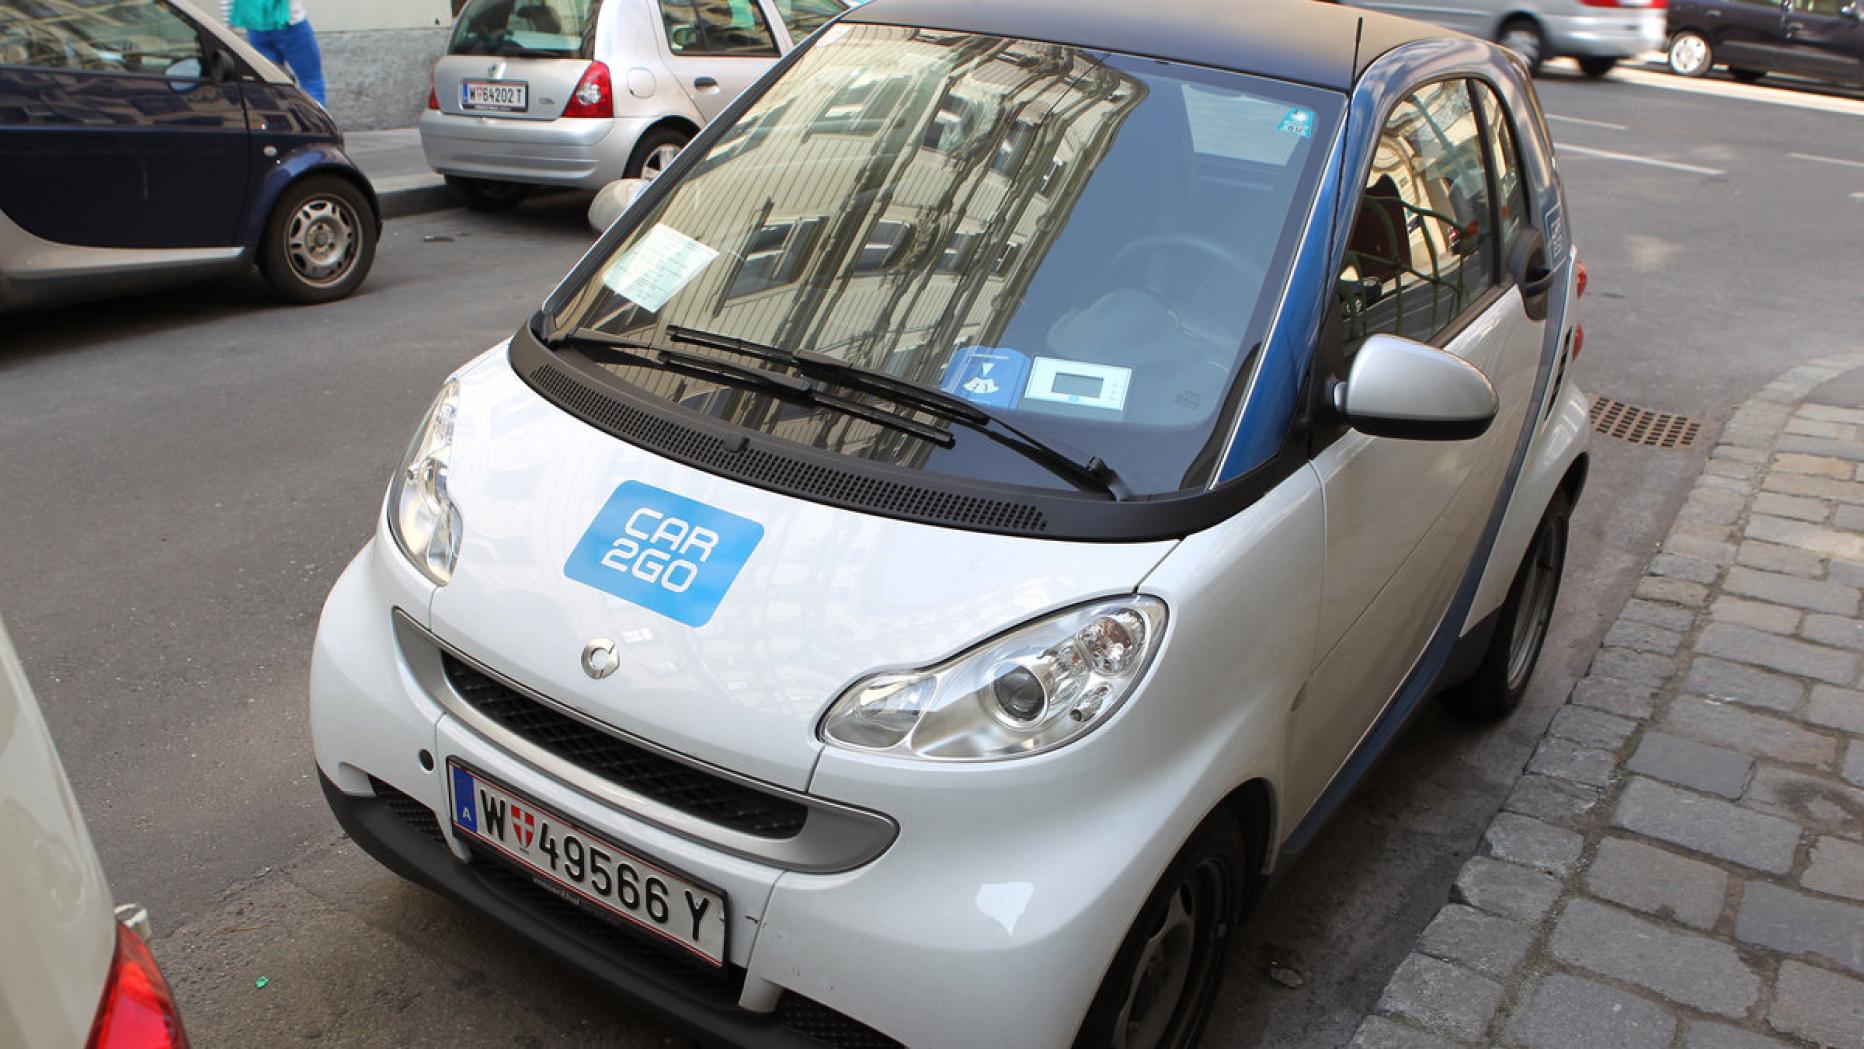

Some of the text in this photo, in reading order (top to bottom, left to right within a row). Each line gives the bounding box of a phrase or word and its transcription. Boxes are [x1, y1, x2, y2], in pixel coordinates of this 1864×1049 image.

[470, 87, 476, 101] W
[482, 87, 514, 103] 64202
[516, 88, 522, 103] T
[624, 507, 720, 562] CAR
[600, 537, 698, 593] 2GO
[462, 806, 472, 822] A
[480, 788, 506, 842] W
[538, 822, 669, 923] 49566
[684, 889, 709, 941] Y
